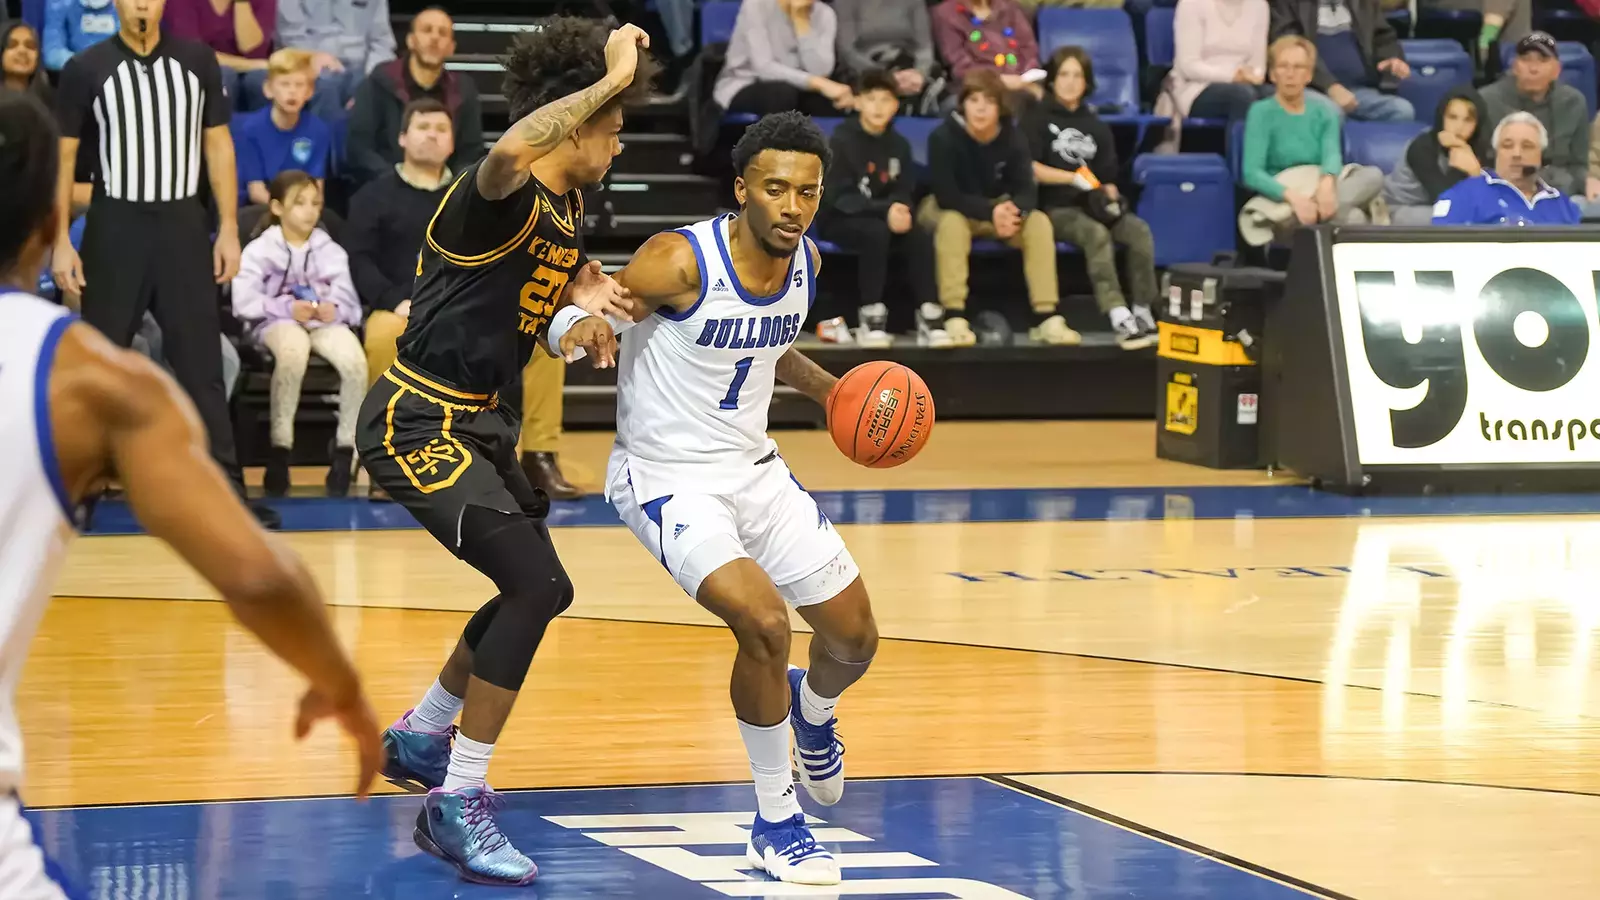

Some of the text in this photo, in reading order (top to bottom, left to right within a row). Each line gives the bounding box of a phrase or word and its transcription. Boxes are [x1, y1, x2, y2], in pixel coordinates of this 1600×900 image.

[695, 313, 800, 349] BULLDOGS
[1353, 267, 1600, 449] yo
[719, 356, 755, 410] 1
[873, 387, 902, 447] LEGACY
[891, 392, 926, 459] SPALDING
